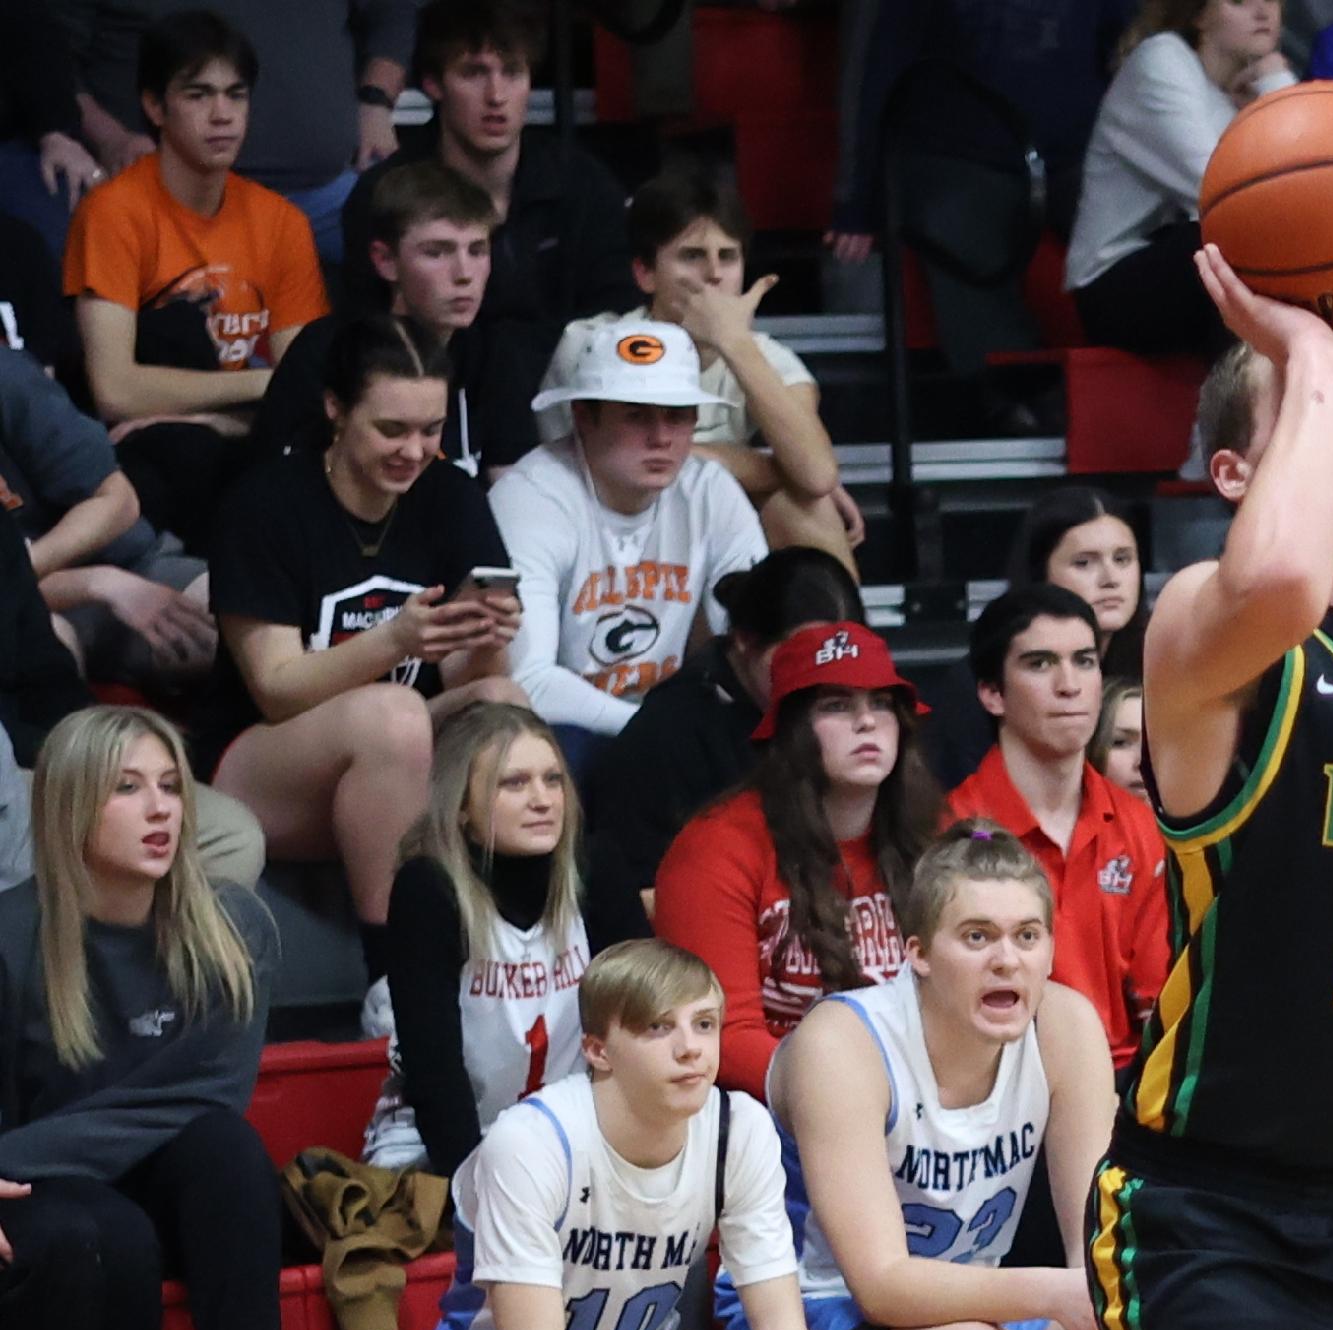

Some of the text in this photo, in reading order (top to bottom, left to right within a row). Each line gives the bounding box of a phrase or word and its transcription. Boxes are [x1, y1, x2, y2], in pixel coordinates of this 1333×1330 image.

[517, 1013, 549, 1102] 1
[981, 1122, 1035, 1178] MAC
[562, 1225, 657, 1270] NORTH
